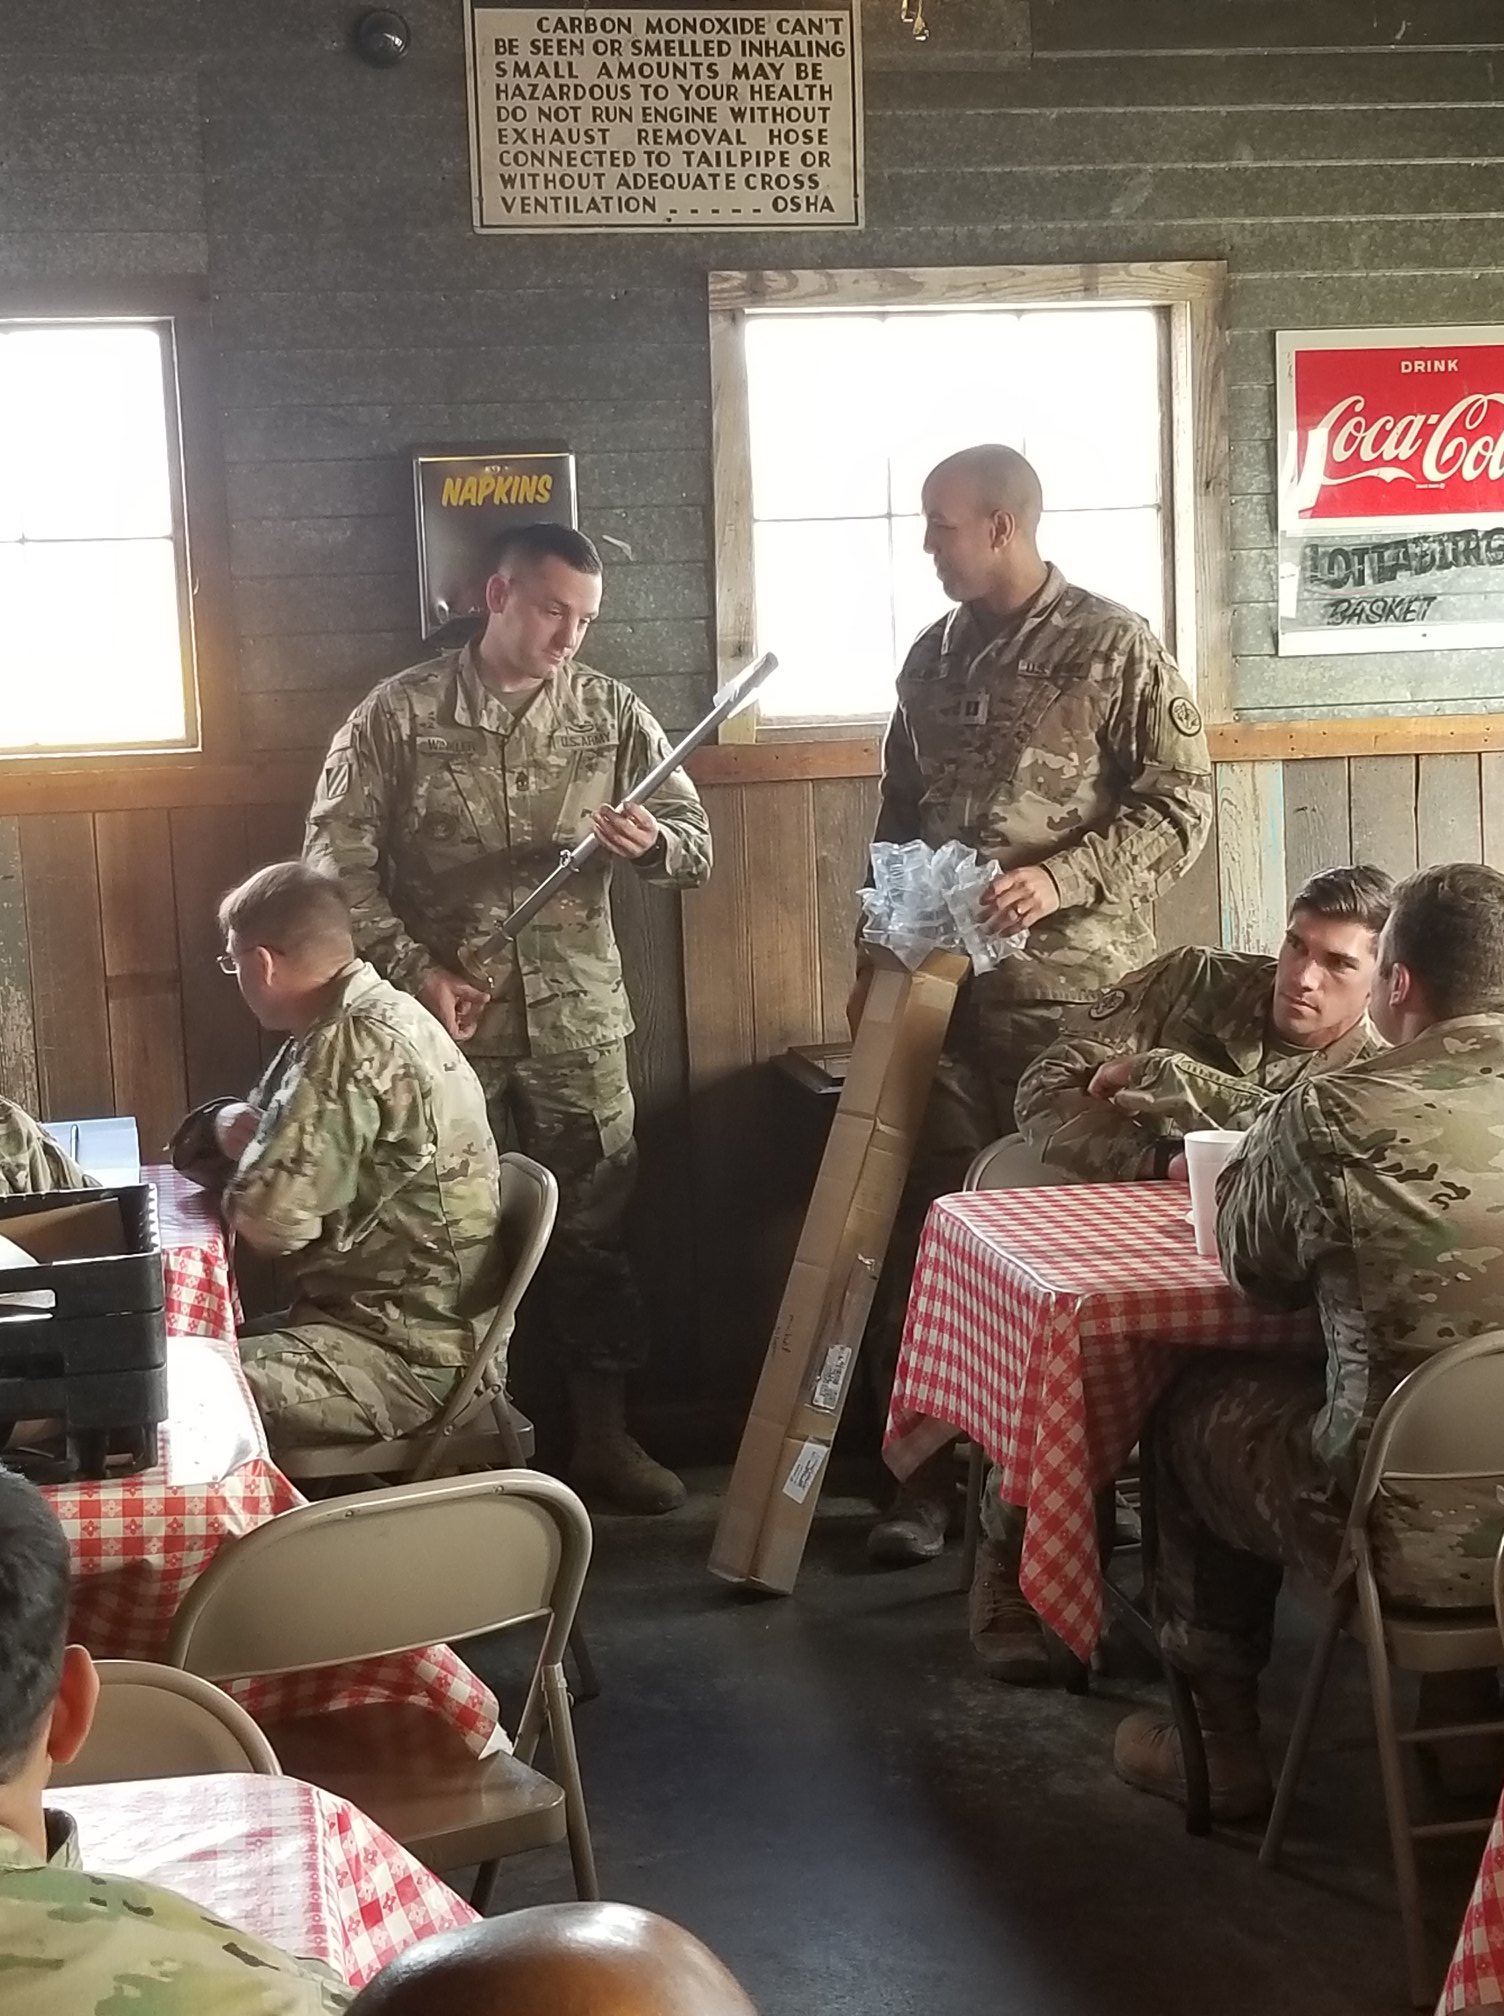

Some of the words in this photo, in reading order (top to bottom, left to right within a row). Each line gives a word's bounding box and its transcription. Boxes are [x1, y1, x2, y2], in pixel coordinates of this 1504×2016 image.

[537, 17, 632, 34] CARBON
[645, 17, 766, 36] MONOXIDE
[776, 18, 844, 36] CAN'T
[495, 39, 519, 56] BE
[529, 39, 584, 56] SEEN
[592, 39, 623, 56] OR
[631, 39, 731, 57] SMELLED
[740, 40, 846, 57] INHALING
[495, 61, 579, 79] SMALL
[597, 62, 719, 80] AMOUNTS
[731, 63, 784, 80] MAY
[795, 63, 823, 80] BE
[495, 83, 632, 101] HAZARDOUS
[640, 84, 669, 101] TO
[677, 84, 739, 101] YOUR
[749, 85, 833, 101] HEALTH
[496, 105, 527, 123] DO
[538, 106, 582, 123] NOT
[592, 106, 633, 123] RUN
[641, 106, 718, 123] ENGINE
[729, 106, 831, 124] WITHOUT
[498, 128, 611, 145] EXHAUST
[637, 129, 747, 145] REMOVAL
[768, 129, 829, 145] HOSE
[499, 150, 636, 167] CONNECTED
[643, 150, 671, 167] TO
[682, 151, 790, 167] TAILPIPE
[800, 151, 831, 167] OR
[499, 173, 606, 190] WITHOUT
[616, 173, 736, 190] ADEQUATE
[744, 173, 820, 190] CROSS
[500, 196, 657, 214] VENTILATION
[771, 196, 835, 213] OSHA
[1400, 359, 1460, 374] DRINK
[441, 474, 552, 507] NAPKINS
[1325, 596, 1437, 626] BASKET
[581, 731, 610, 746] ARMY
